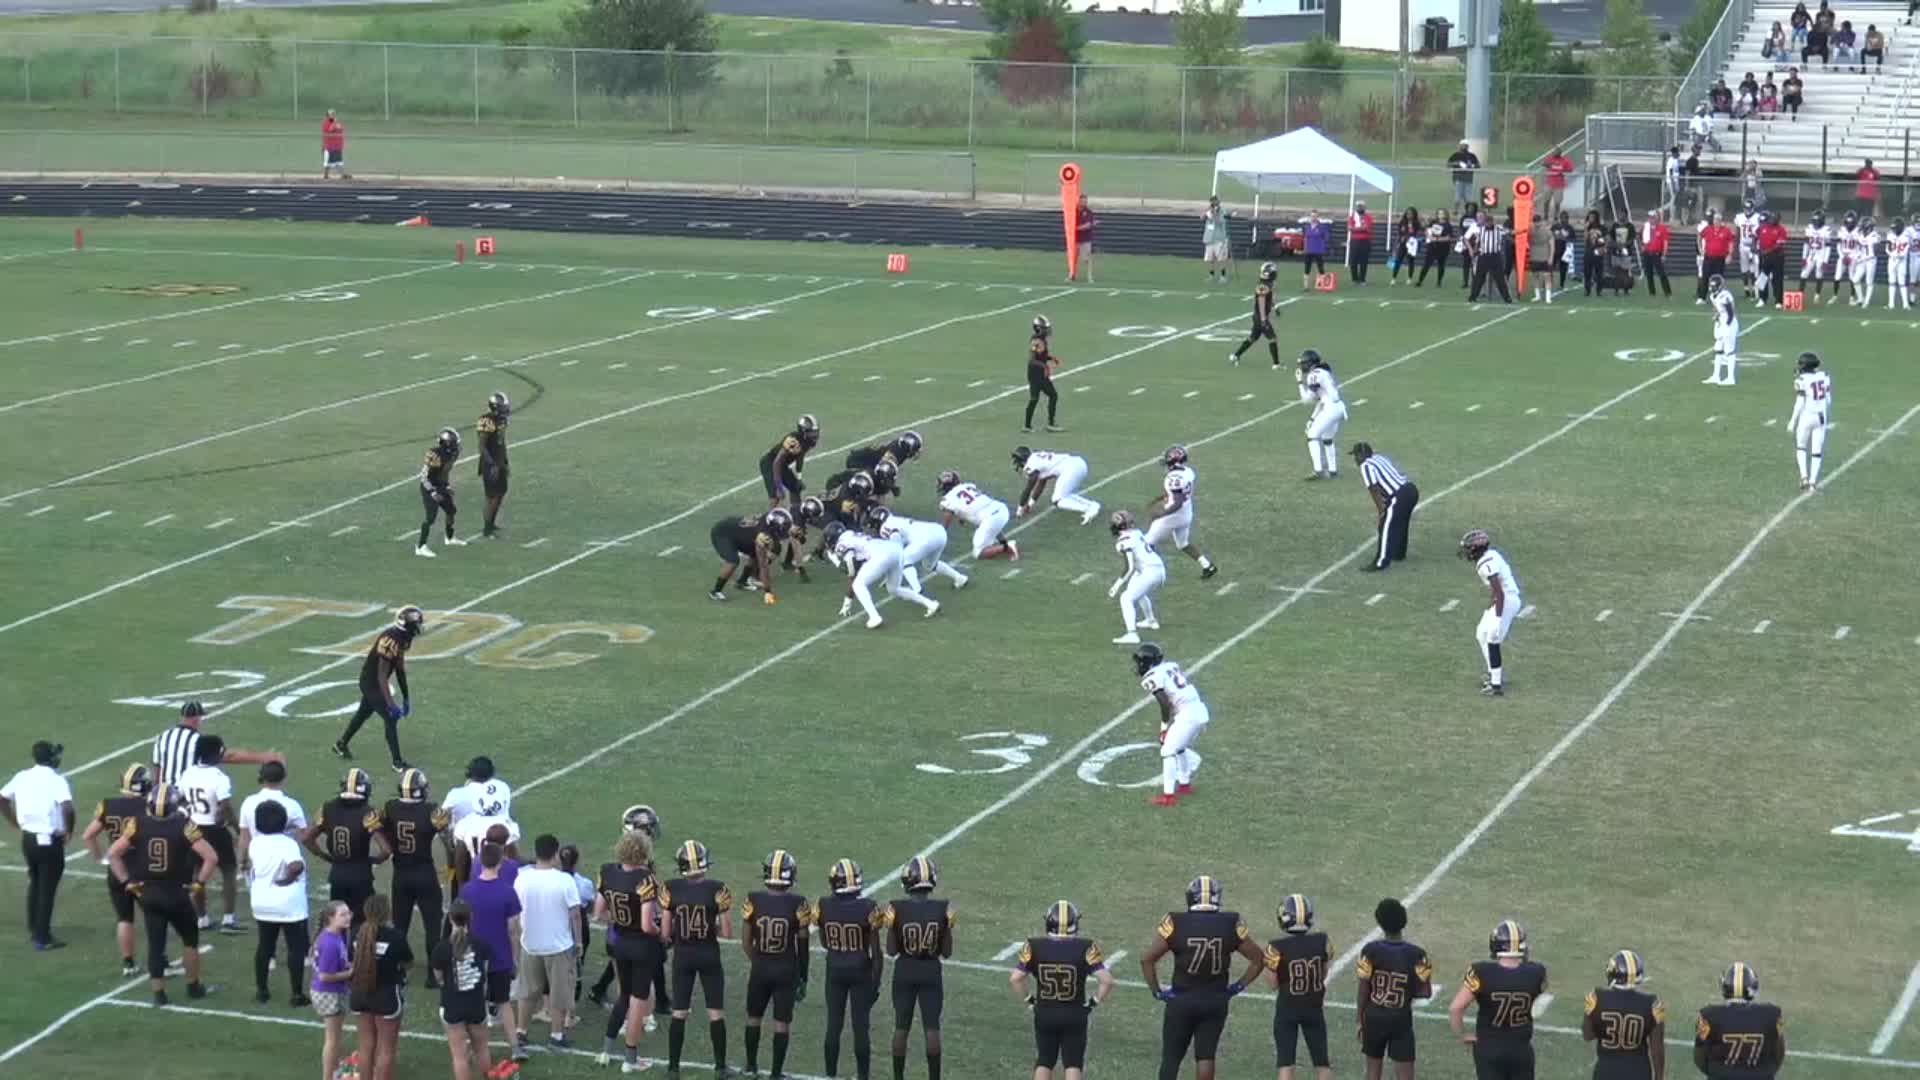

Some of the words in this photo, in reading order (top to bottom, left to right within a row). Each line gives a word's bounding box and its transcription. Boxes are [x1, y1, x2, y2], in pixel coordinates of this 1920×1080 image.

[1483, 187, 1497, 206] 3
[479, 240, 490, 255] G
[890, 255, 905, 271] 10
[1784, 293, 1801, 309] 30
[1810, 380, 1825, 401] 15
[914, 731, 1166, 789] 30
[148, 837, 168, 872] 9
[332, 825, 350, 859] 8
[397, 820, 416, 854] 5
[676, 904, 710, 940] 14
[756, 916, 790, 953] 19
[1187, 937, 1224, 975] 71
[1038, 963, 1078, 1002] 53
[1288, 955, 1324, 996] 81
[1491, 991, 1533, 1029] 72
[1600, 1010, 1646, 1050] 30
[1721, 1032, 1766, 1067] 77
